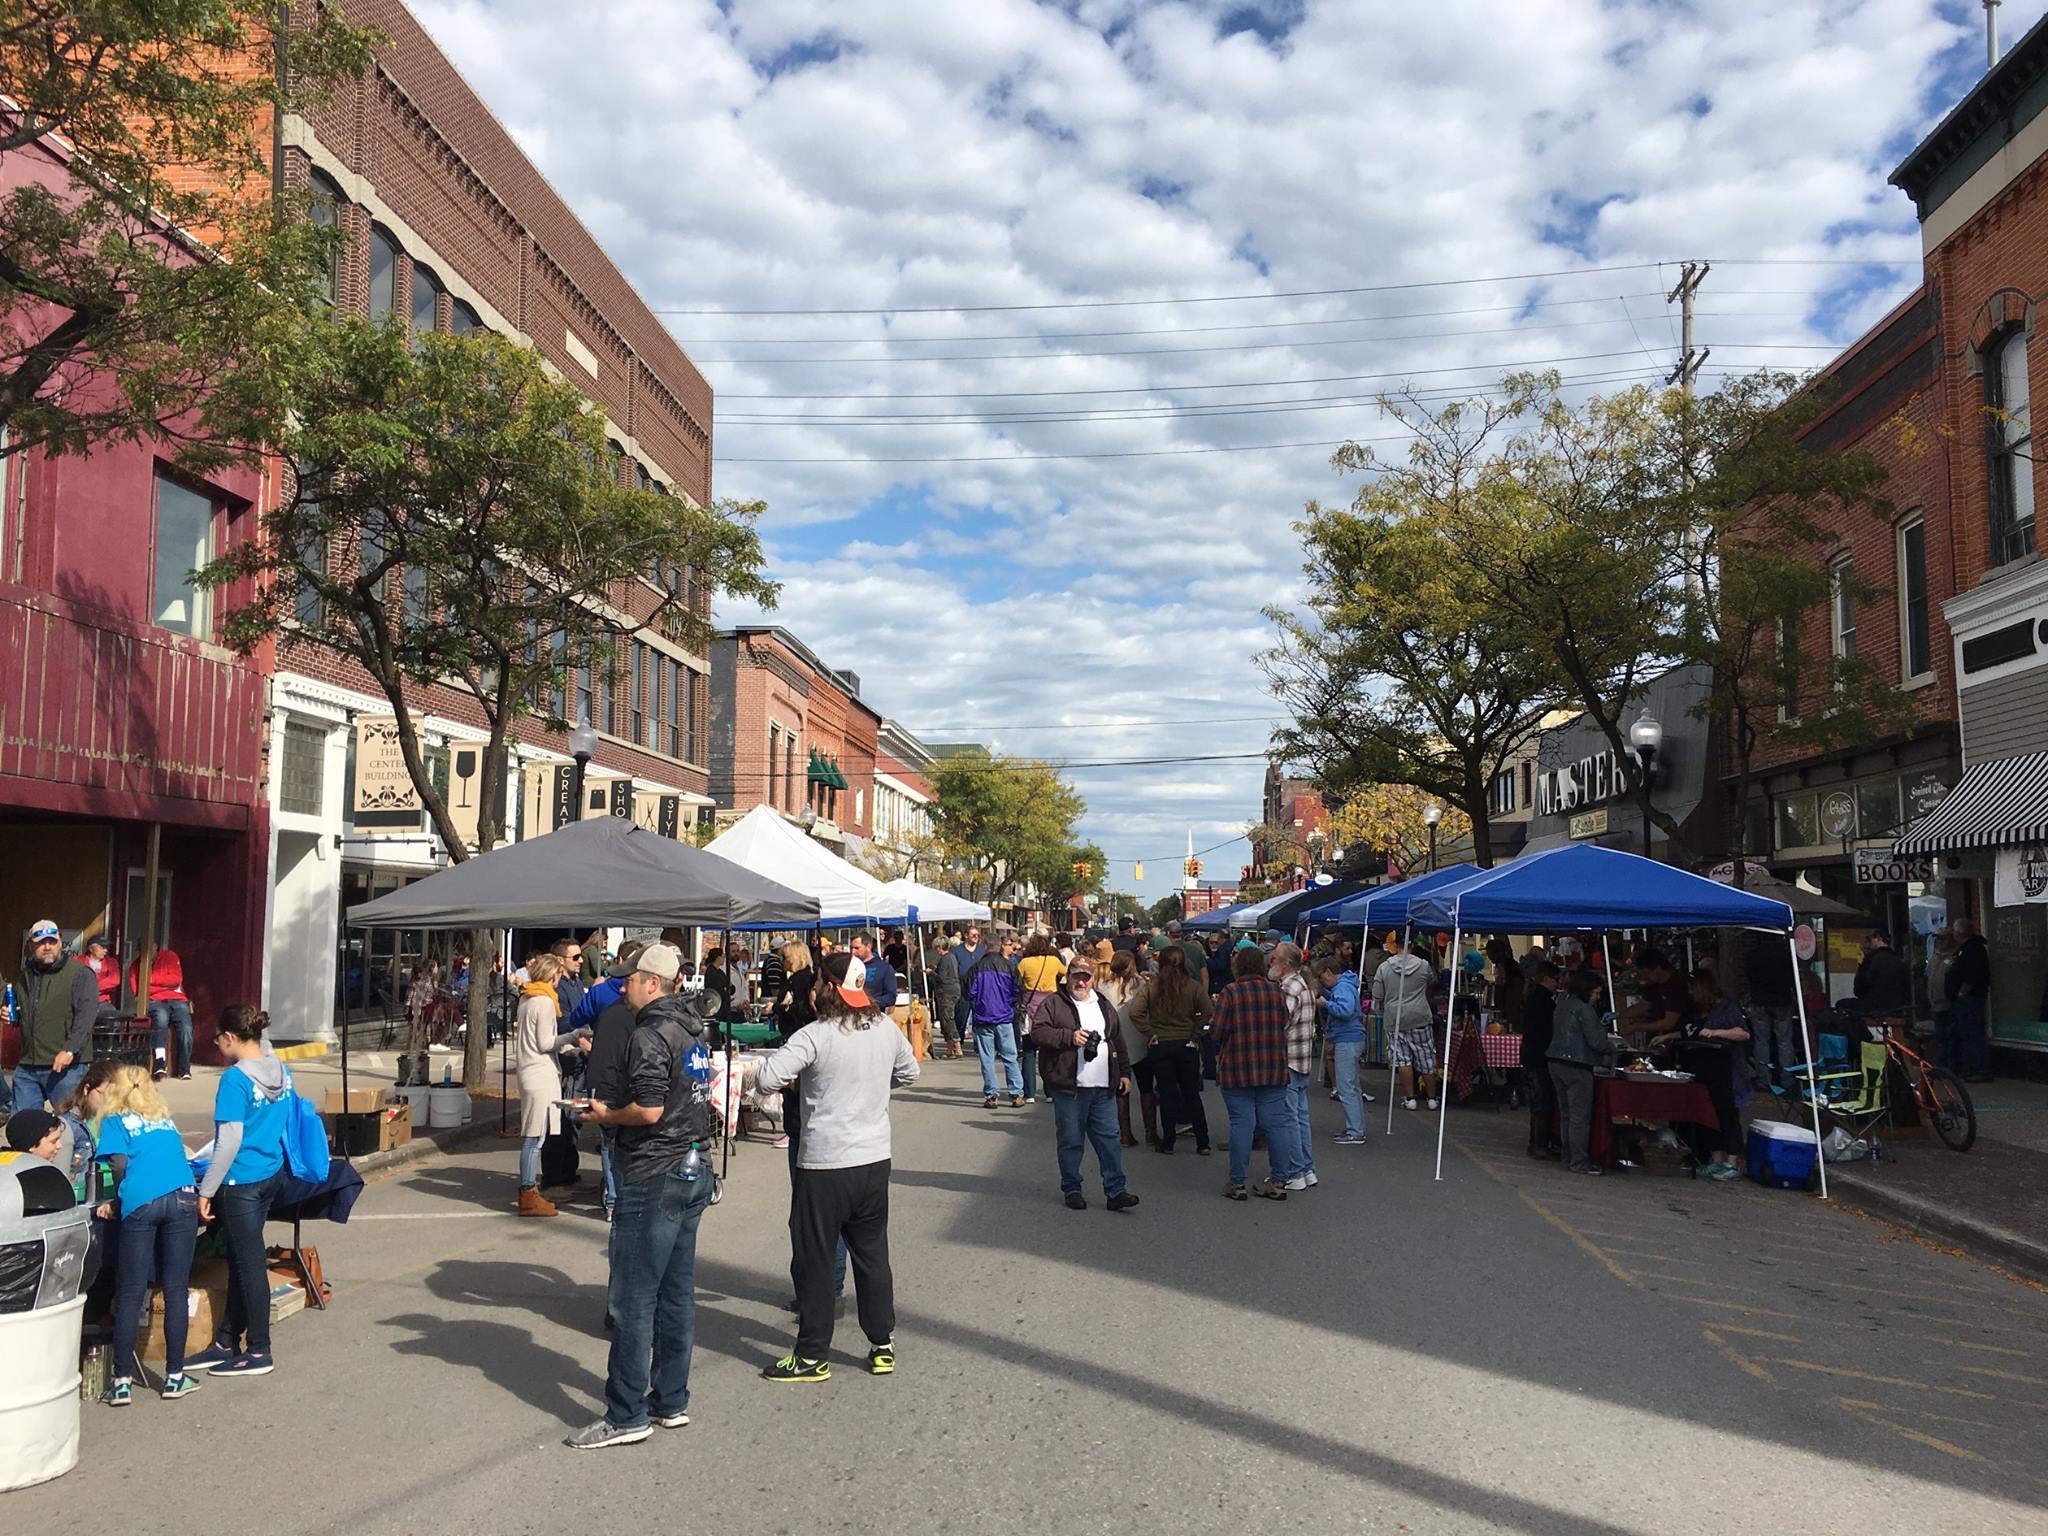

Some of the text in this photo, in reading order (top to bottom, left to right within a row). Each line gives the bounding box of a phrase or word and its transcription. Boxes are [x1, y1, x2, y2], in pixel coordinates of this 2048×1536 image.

[379, 747, 400, 757] THE
[615, 783, 626, 818] SHO
[1856, 862, 1932, 882] BOOKS
